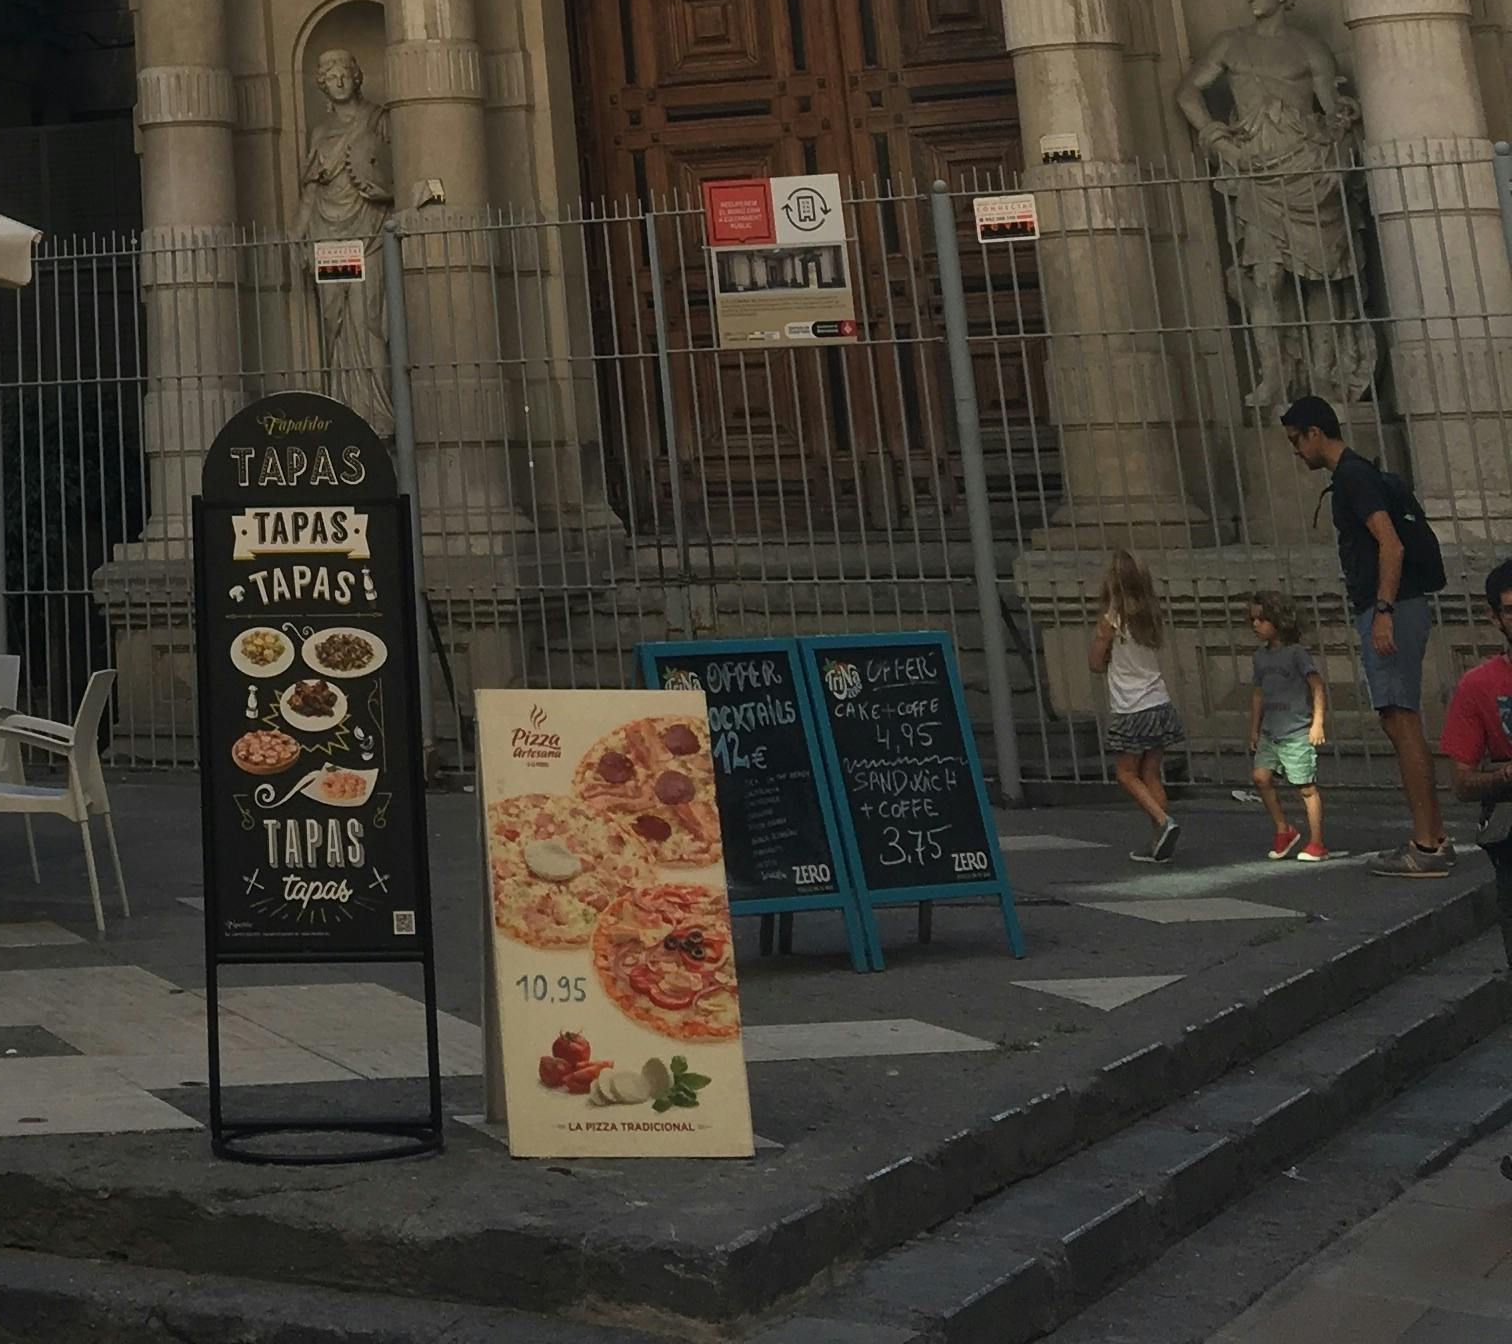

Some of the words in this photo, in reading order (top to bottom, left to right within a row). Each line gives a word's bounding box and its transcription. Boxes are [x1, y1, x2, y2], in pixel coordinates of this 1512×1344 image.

[230, 446, 366, 487] TAPAS
[252, 511, 349, 545] TAPAS
[248, 565, 356, 605] TAPAS
[706, 660, 783, 694] OFFER
[834, 700, 881, 721] CAKE
[897, 698, 940, 718] COFFE
[511, 727, 562, 749] Pizza
[878, 798, 940, 819] COFFE
[263, 818, 366, 869] TAPAS
[792, 863, 831, 885] ZERO
[951, 852, 988, 872] ZERO
[281, 873, 354, 910] tapas
[567, 1121, 583, 1132] LA
[584, 1121, 619, 1133] PIZZA
[620, 1121, 696, 1133] TRADICIONAL
